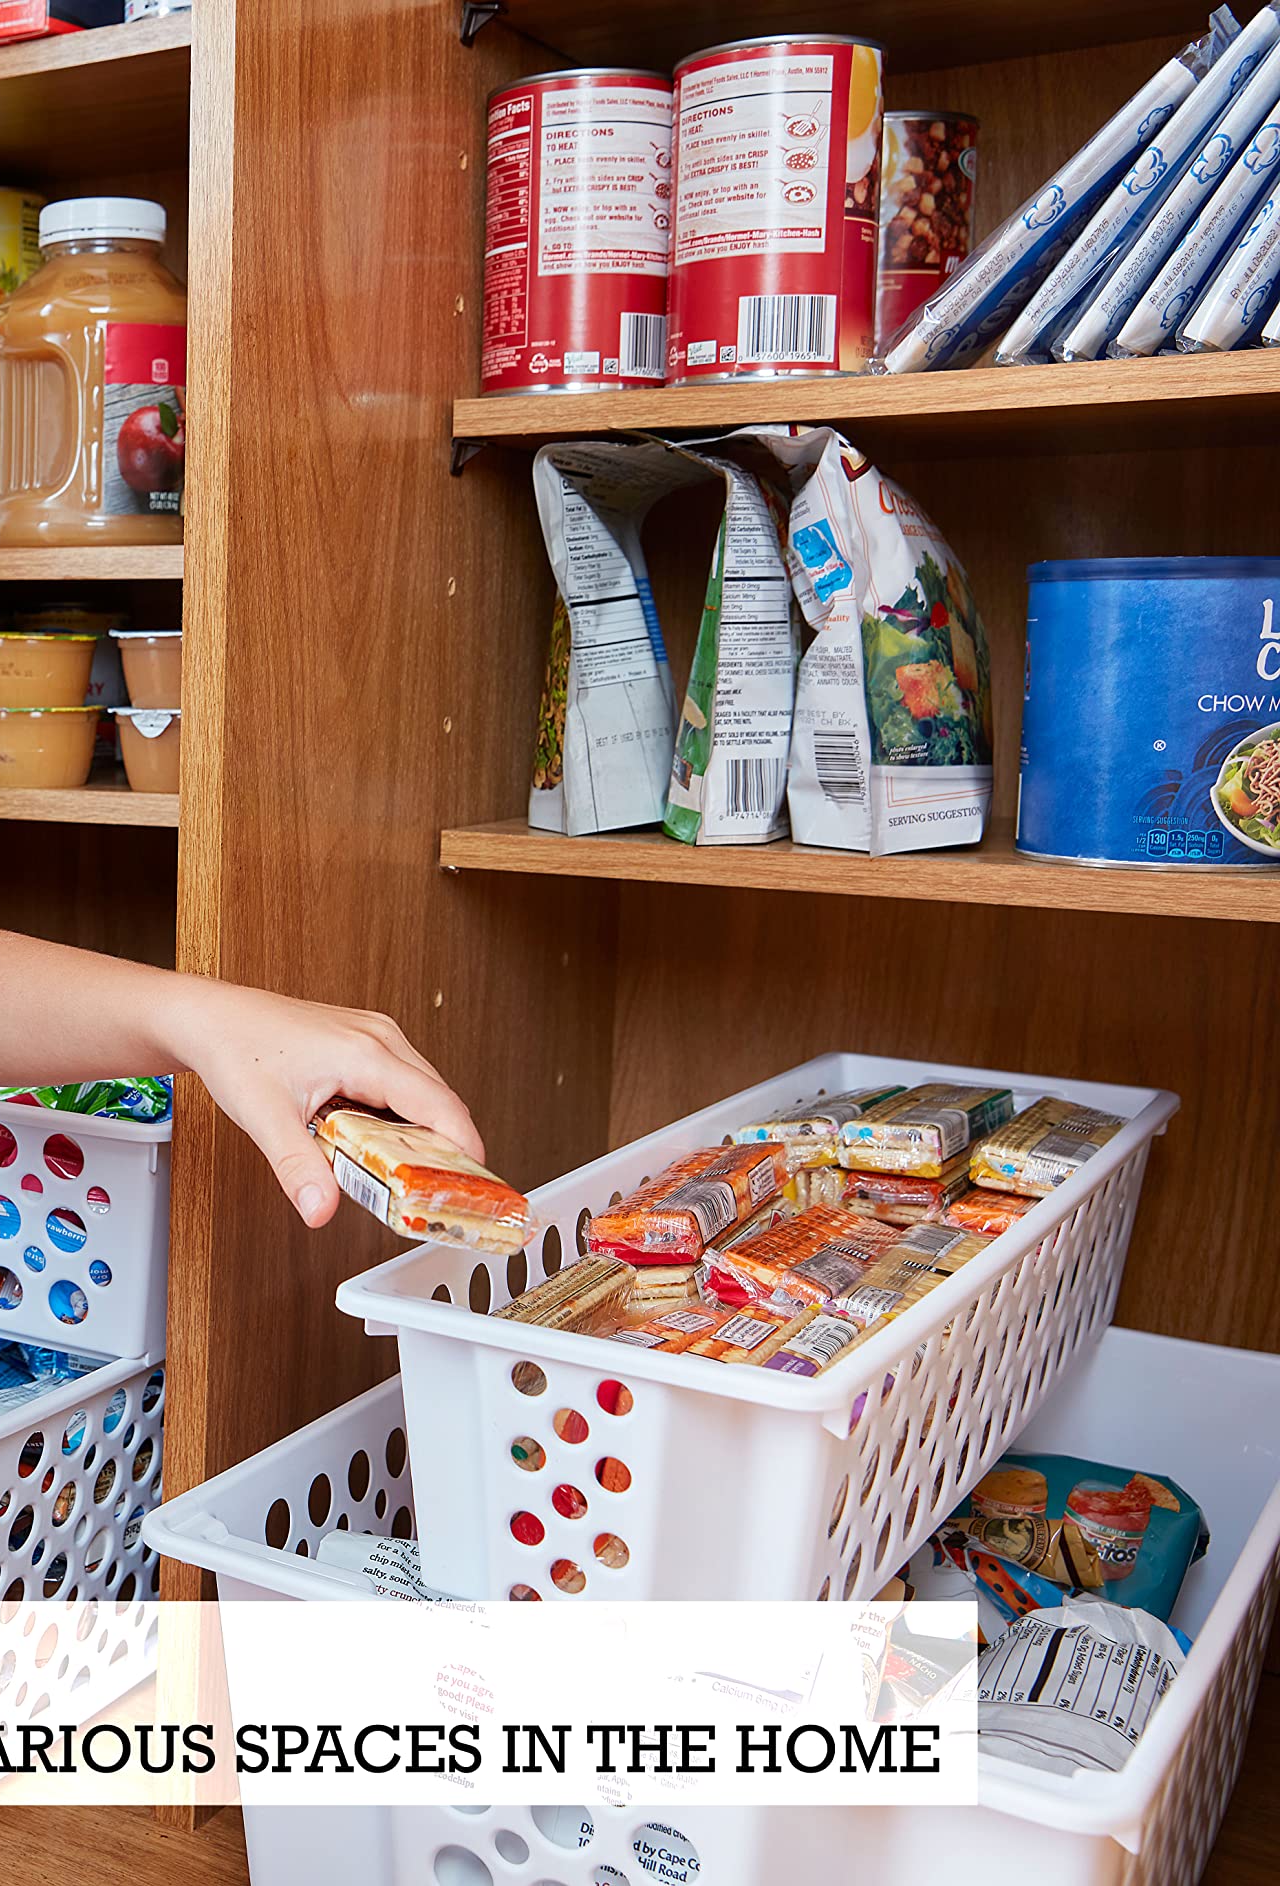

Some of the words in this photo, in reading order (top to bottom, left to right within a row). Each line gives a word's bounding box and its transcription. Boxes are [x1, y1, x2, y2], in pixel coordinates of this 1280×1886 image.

[507, 101, 531, 116] Facts
[682, 106, 734, 126] DIRECTIONS
[716, 133, 737, 145] evenly
[747, 150, 769, 159] CRISP
[727, 192, 754, 202] website
[729, 241, 751, 251] ENJOY
[1148, 291, 1160, 305] BY
[1230, 285, 1242, 300] BY
[755, 352, 785, 361] 37600
[790, 352, 817, 361] 19651
[1198, 694, 1265, 712] CHOW
[904, 743, 927, 753] enlarged
[888, 813, 926, 827] SERVING
[1132, 815, 1154, 824] SERVING
[1150, 833, 1166, 845] 130
[47, 1221, 86, 1243] rawberry
[369, 1552, 389, 1567] chip
[377, 1542, 391, 1551] for
[401, 1551, 411, 1565] bit
[362, 1566, 387, 1580] salty,
[389, 1575, 410, 1587] sour
[909, 1657, 937, 1681] NACHO
[451, 1675, 470, 1691] you
[438, 1686, 464, 1703] good!
[712, 1680, 755, 1702] Calcium
[459, 1707, 479, 1723] visit
[642, 1843, 657, 1857] by
[658, 1848, 686, 1866] Cape
[659, 1863, 688, 1883] Road
